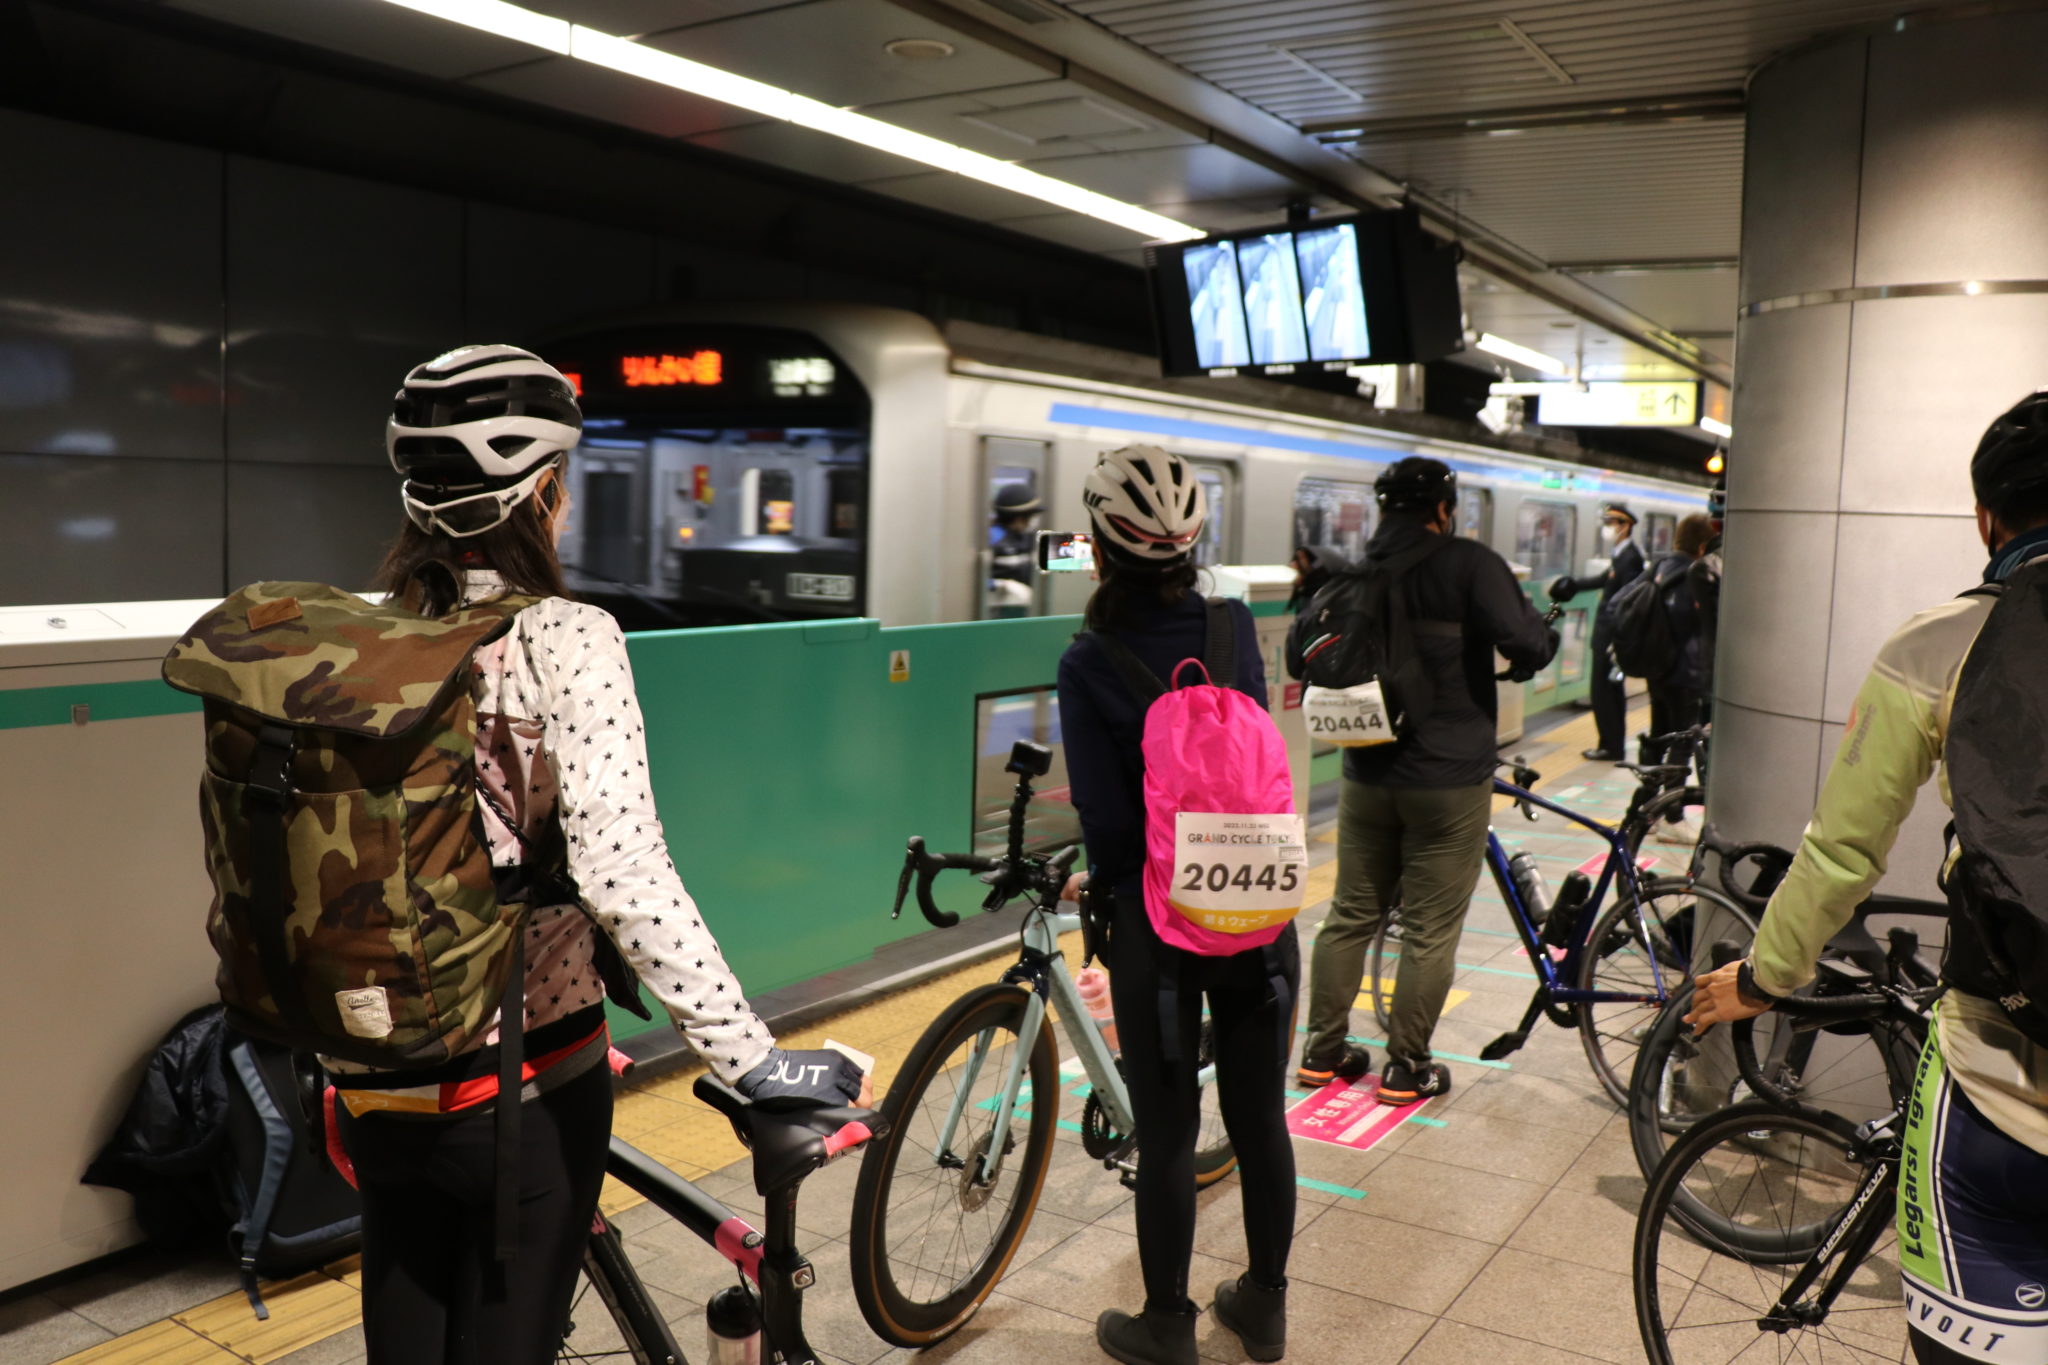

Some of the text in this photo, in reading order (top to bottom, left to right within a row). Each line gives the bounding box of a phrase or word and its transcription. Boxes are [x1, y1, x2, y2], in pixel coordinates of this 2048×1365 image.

[1310, 713, 1383, 732] 20444
[1187, 833, 1228, 844] GRAND
[1231, 833, 1262, 844] CYCLE
[1181, 862, 1298, 892] 20445
[1904, 1144, 1925, 1260] Legarsi
